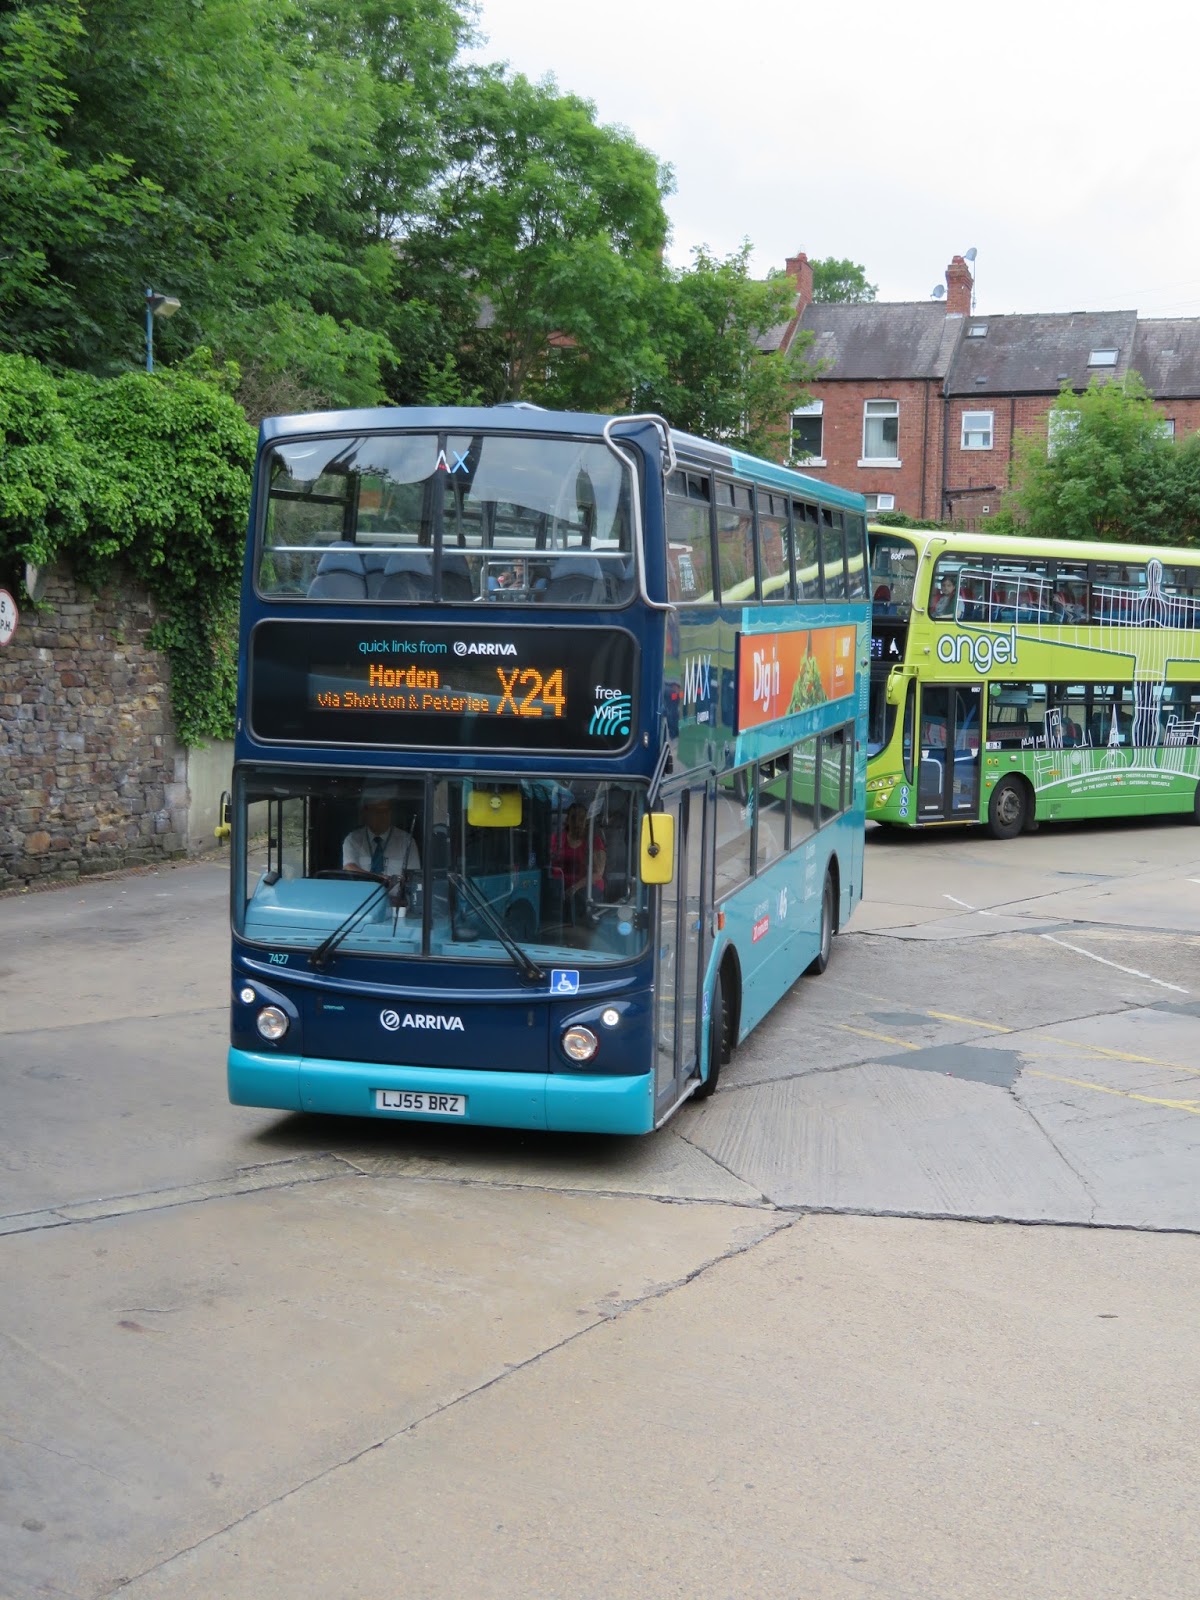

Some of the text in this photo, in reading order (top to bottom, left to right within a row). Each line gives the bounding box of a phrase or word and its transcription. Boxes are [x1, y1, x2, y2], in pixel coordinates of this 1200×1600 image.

[358, 640, 518, 656] quick links from ARRIVA
[937, 625, 1018, 674] angel
[369, 664, 439, 689] Horden
[683, 654, 711, 706] MAX
[753, 648, 771, 713] Dig
[318, 691, 489, 712] via Shotton & Peterlee
[496, 668, 566, 717] X24
[595, 685, 622, 700] free
[594, 705, 622, 720] WiFi
[268, 952, 289, 965] 7427
[402, 1013, 465, 1031] ARRIVA
[382, 1092, 459, 1112] LJ55 BRZ
